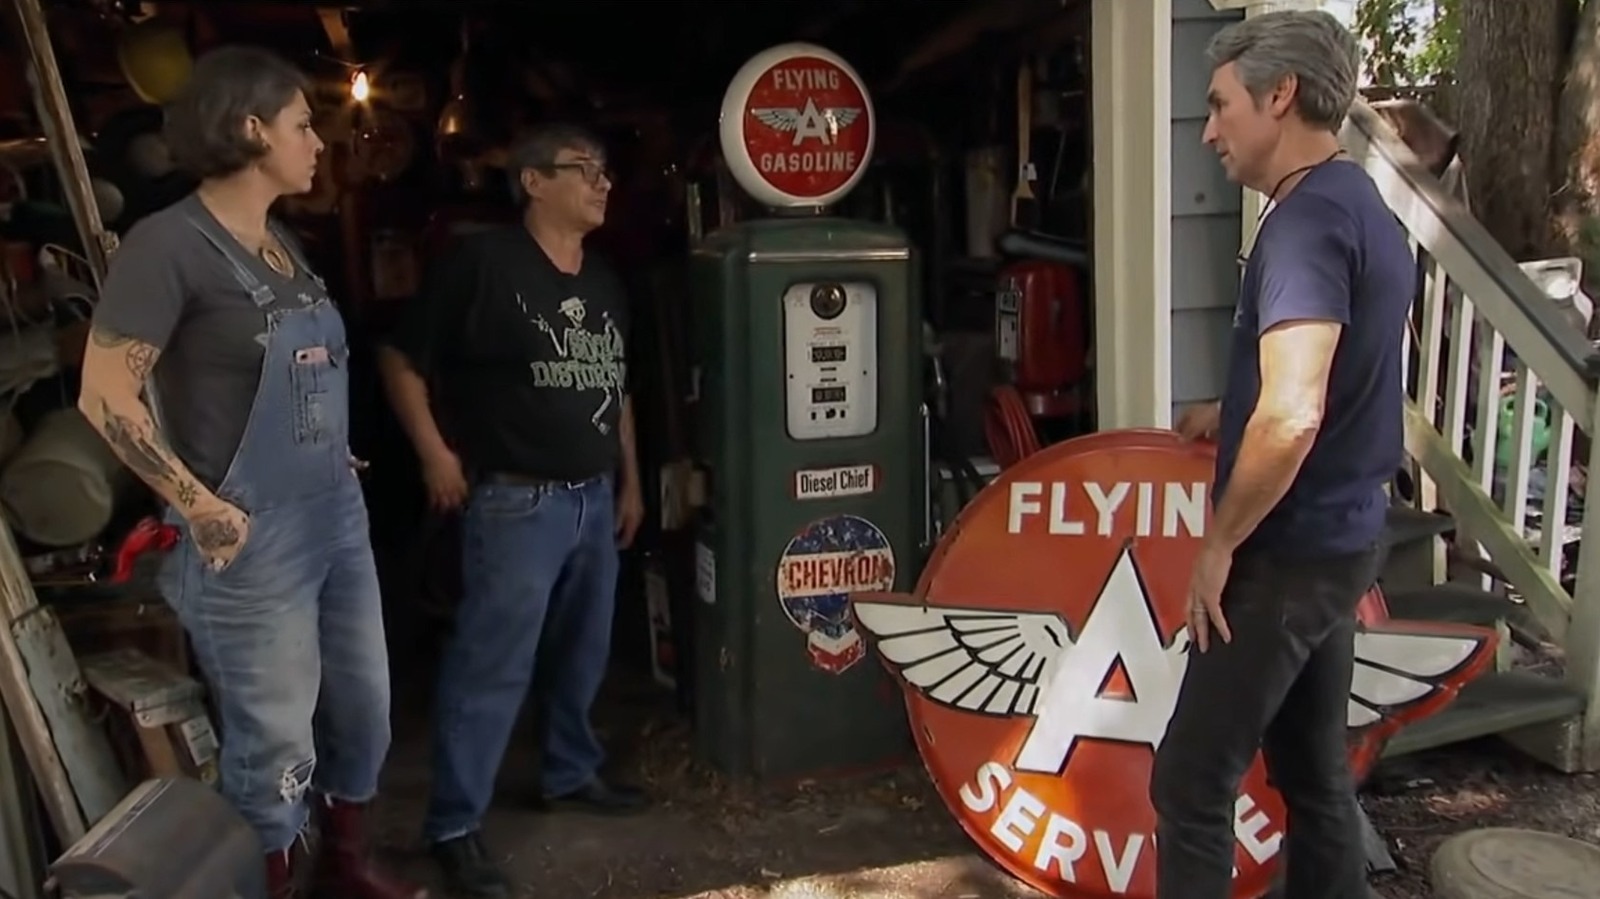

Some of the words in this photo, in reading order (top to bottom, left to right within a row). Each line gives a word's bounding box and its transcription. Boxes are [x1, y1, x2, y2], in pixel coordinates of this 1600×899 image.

[773, 69, 840, 91] FLYING
[792, 96, 831, 146] A
[760, 151, 856, 173] GASOLINE
[801, 472, 837, 493] Diesel
[840, 468, 869, 488] Chief
[1008, 482, 1206, 538] FLYIN
[1014, 547, 1182, 775] A
[959, 761, 1283, 893] SERVE
